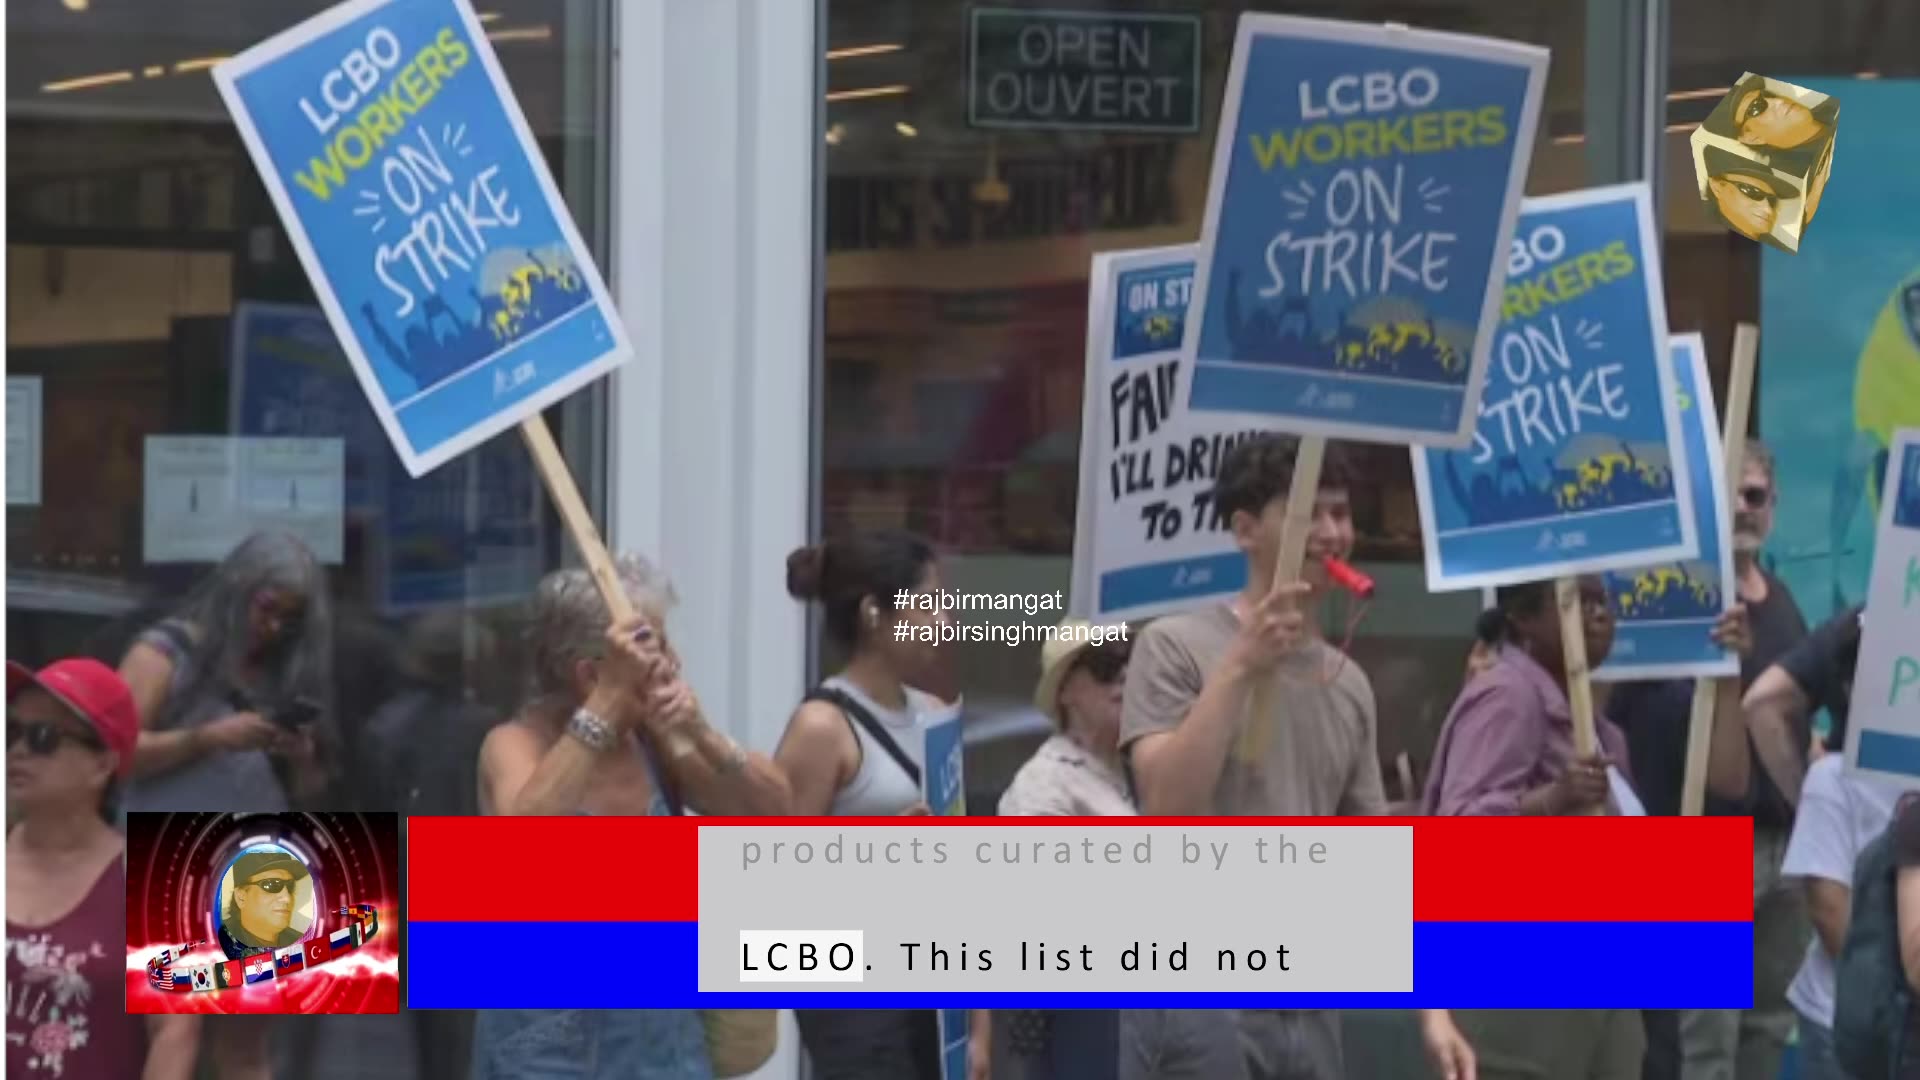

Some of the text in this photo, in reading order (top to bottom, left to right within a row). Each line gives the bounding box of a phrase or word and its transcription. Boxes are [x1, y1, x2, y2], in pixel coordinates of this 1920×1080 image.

[1019, 23, 1151, 69] OPEN
[299, 26, 399, 134] LCBO
[987, 71, 1181, 119] OUVERT
[1299, 67, 1438, 119] LCBO
[294, 27, 470, 201] WORKERS
[1249, 105, 1507, 172] WORKERS
[383, 126, 454, 215] ON
[1325, 164, 1404, 226] ON
[375, 165, 520, 316] STRIKE
[1259, 229, 1458, 298] STRIKE
[1507, 225, 1565, 274] BO
[1128, 277, 1193, 312] ON ST
[1502, 242, 1636, 321] RKERS
[1502, 315, 1570, 385] ON
[1139, 499, 1183, 543] TO
